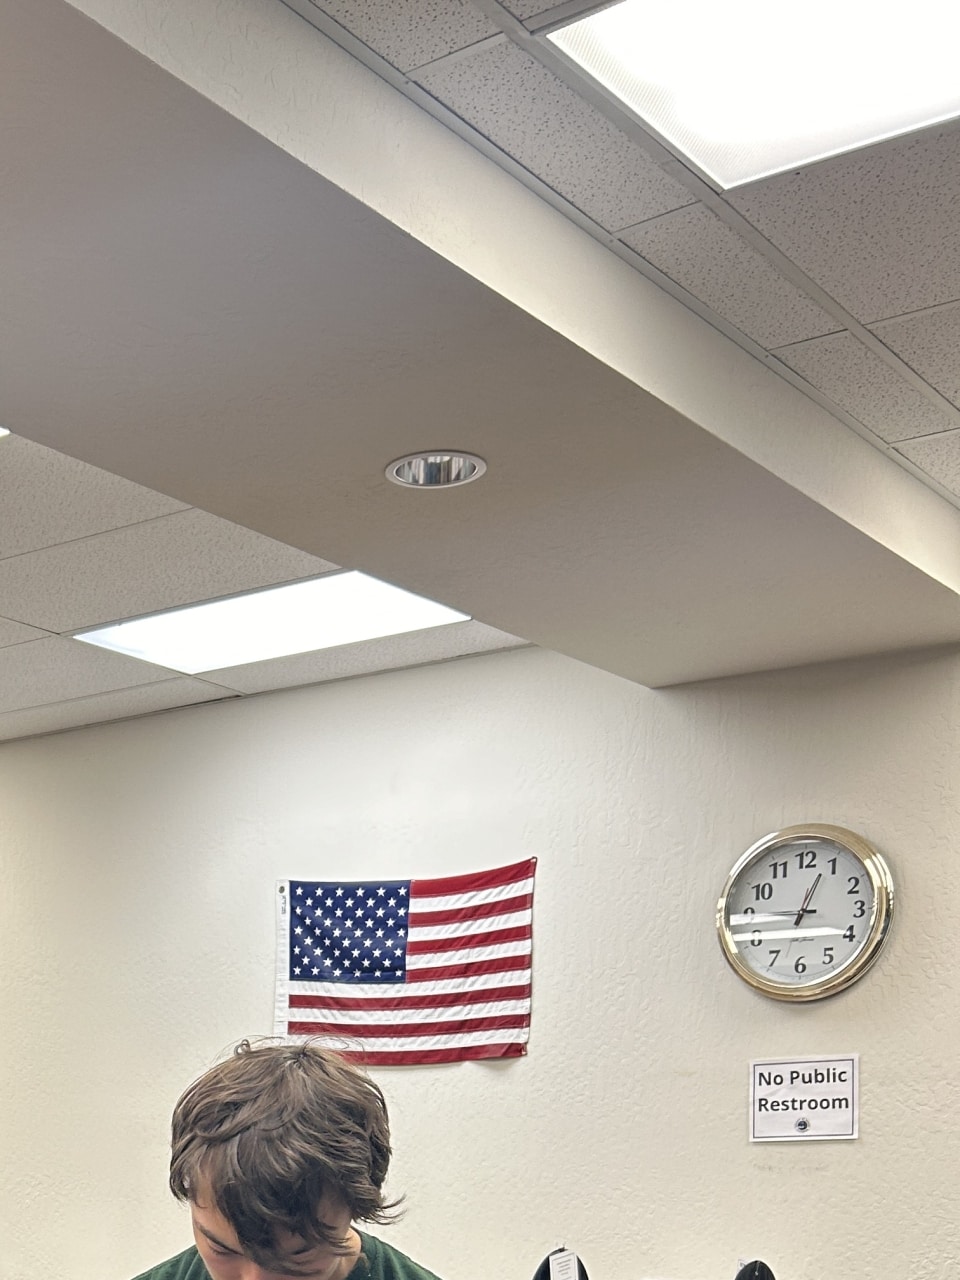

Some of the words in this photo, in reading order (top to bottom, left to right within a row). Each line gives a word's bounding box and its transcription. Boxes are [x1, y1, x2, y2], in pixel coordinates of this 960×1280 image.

[795, 850, 817, 869] 12
[827, 857, 837, 875] 1
[769, 861, 788, 879] 11
[751, 882, 773, 901] 10
[847, 876, 860, 894] 2
[853, 900, 866, 918] 3
[750, 930, 762, 946] 8
[843, 924, 856, 942] 4
[769, 950, 781, 967] 7
[794, 955, 806, 973] 6
[822, 947, 834, 964] 5
[758, 1071, 784, 1086] No
[790, 1067, 847, 1085] Public
[758, 1096, 849, 1112] Restroom
